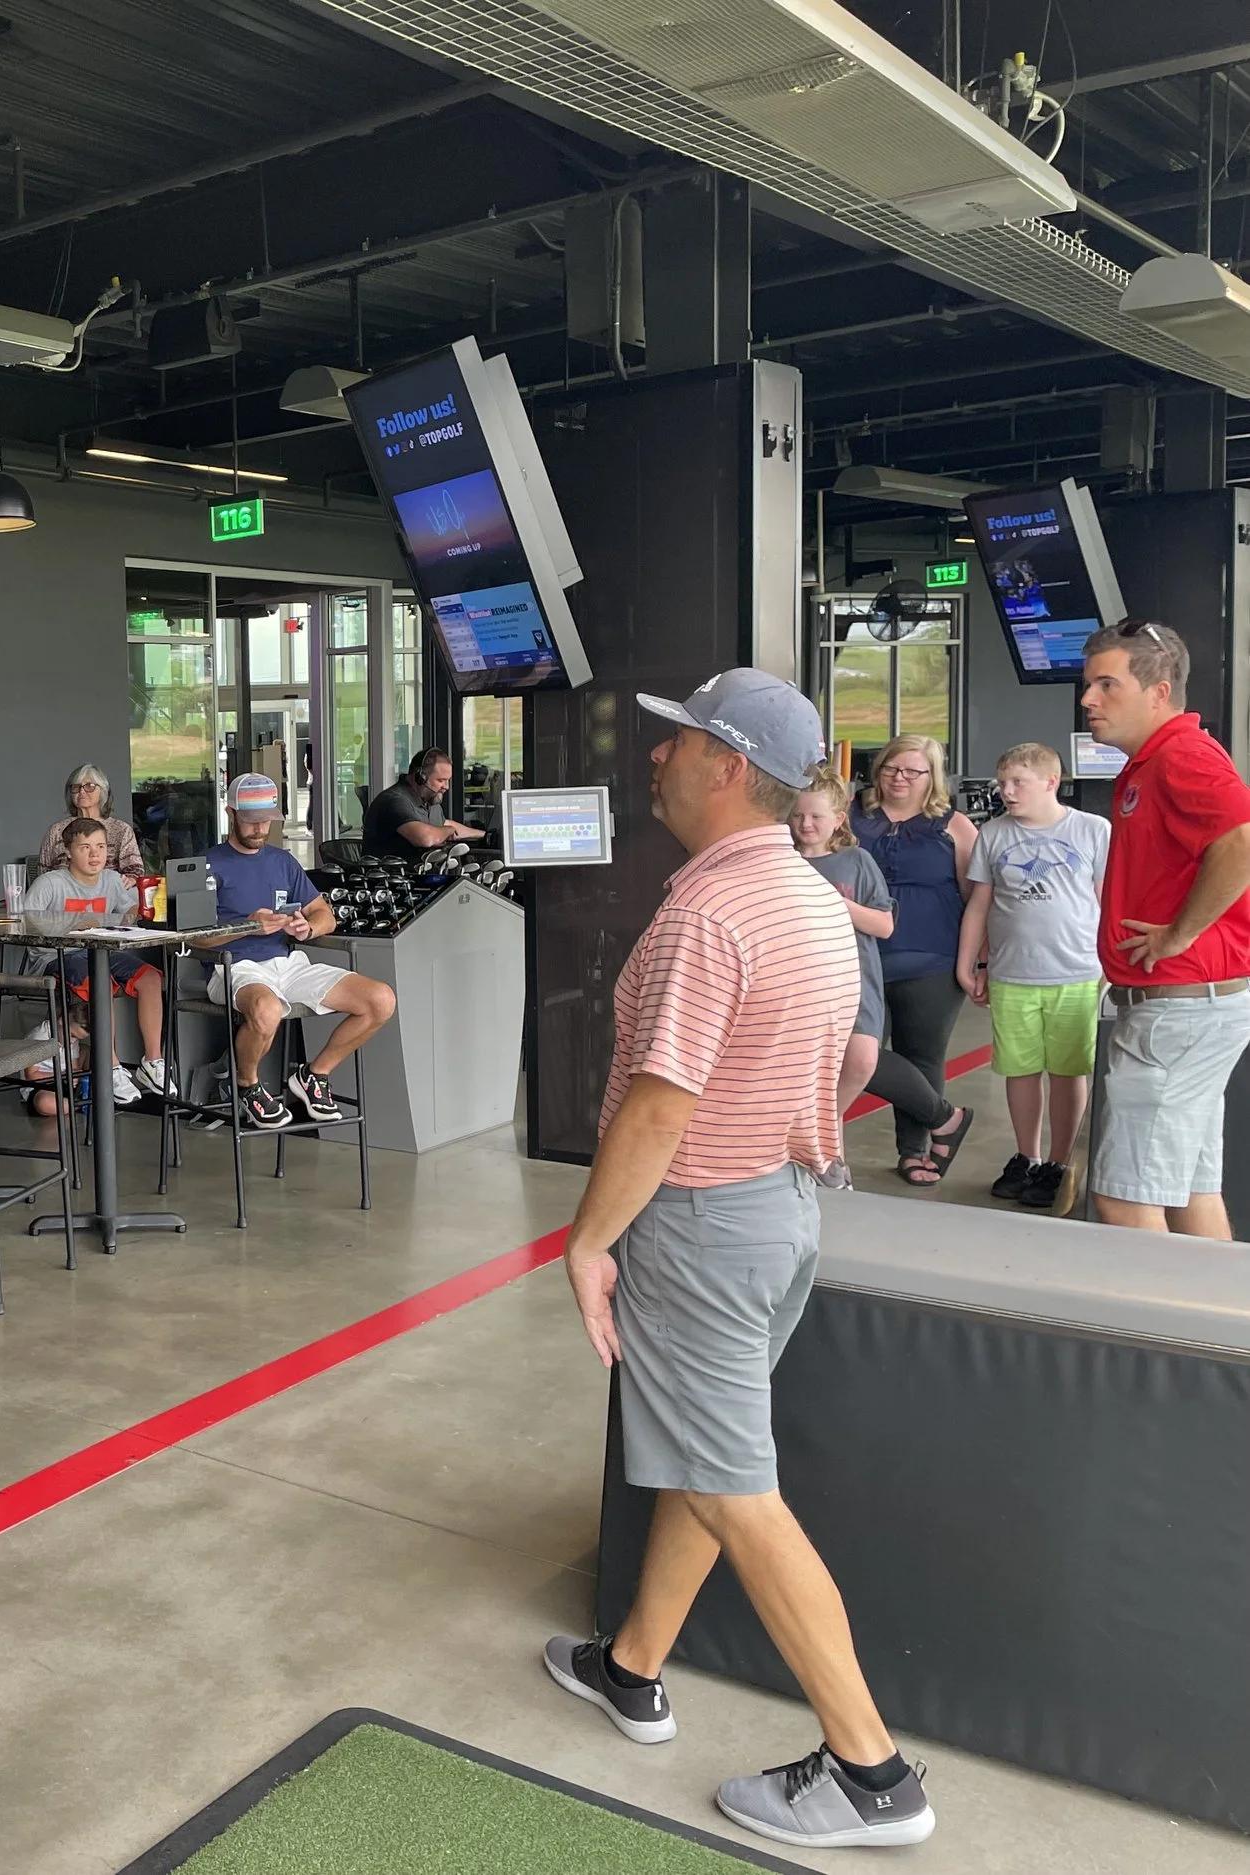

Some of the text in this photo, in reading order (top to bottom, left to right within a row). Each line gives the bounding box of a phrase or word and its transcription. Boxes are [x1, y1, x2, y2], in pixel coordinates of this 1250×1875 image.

[376, 393, 457, 438] Follow us!
[419, 422, 464, 447] @TOPGOLF
[220, 506, 252, 531] 116
[986, 508, 1056, 529] Follow us!
[447, 542, 481, 557] COMING UP
[491, 603, 529, 617] REIMAGINED
[710, 719, 758, 750] APEX
